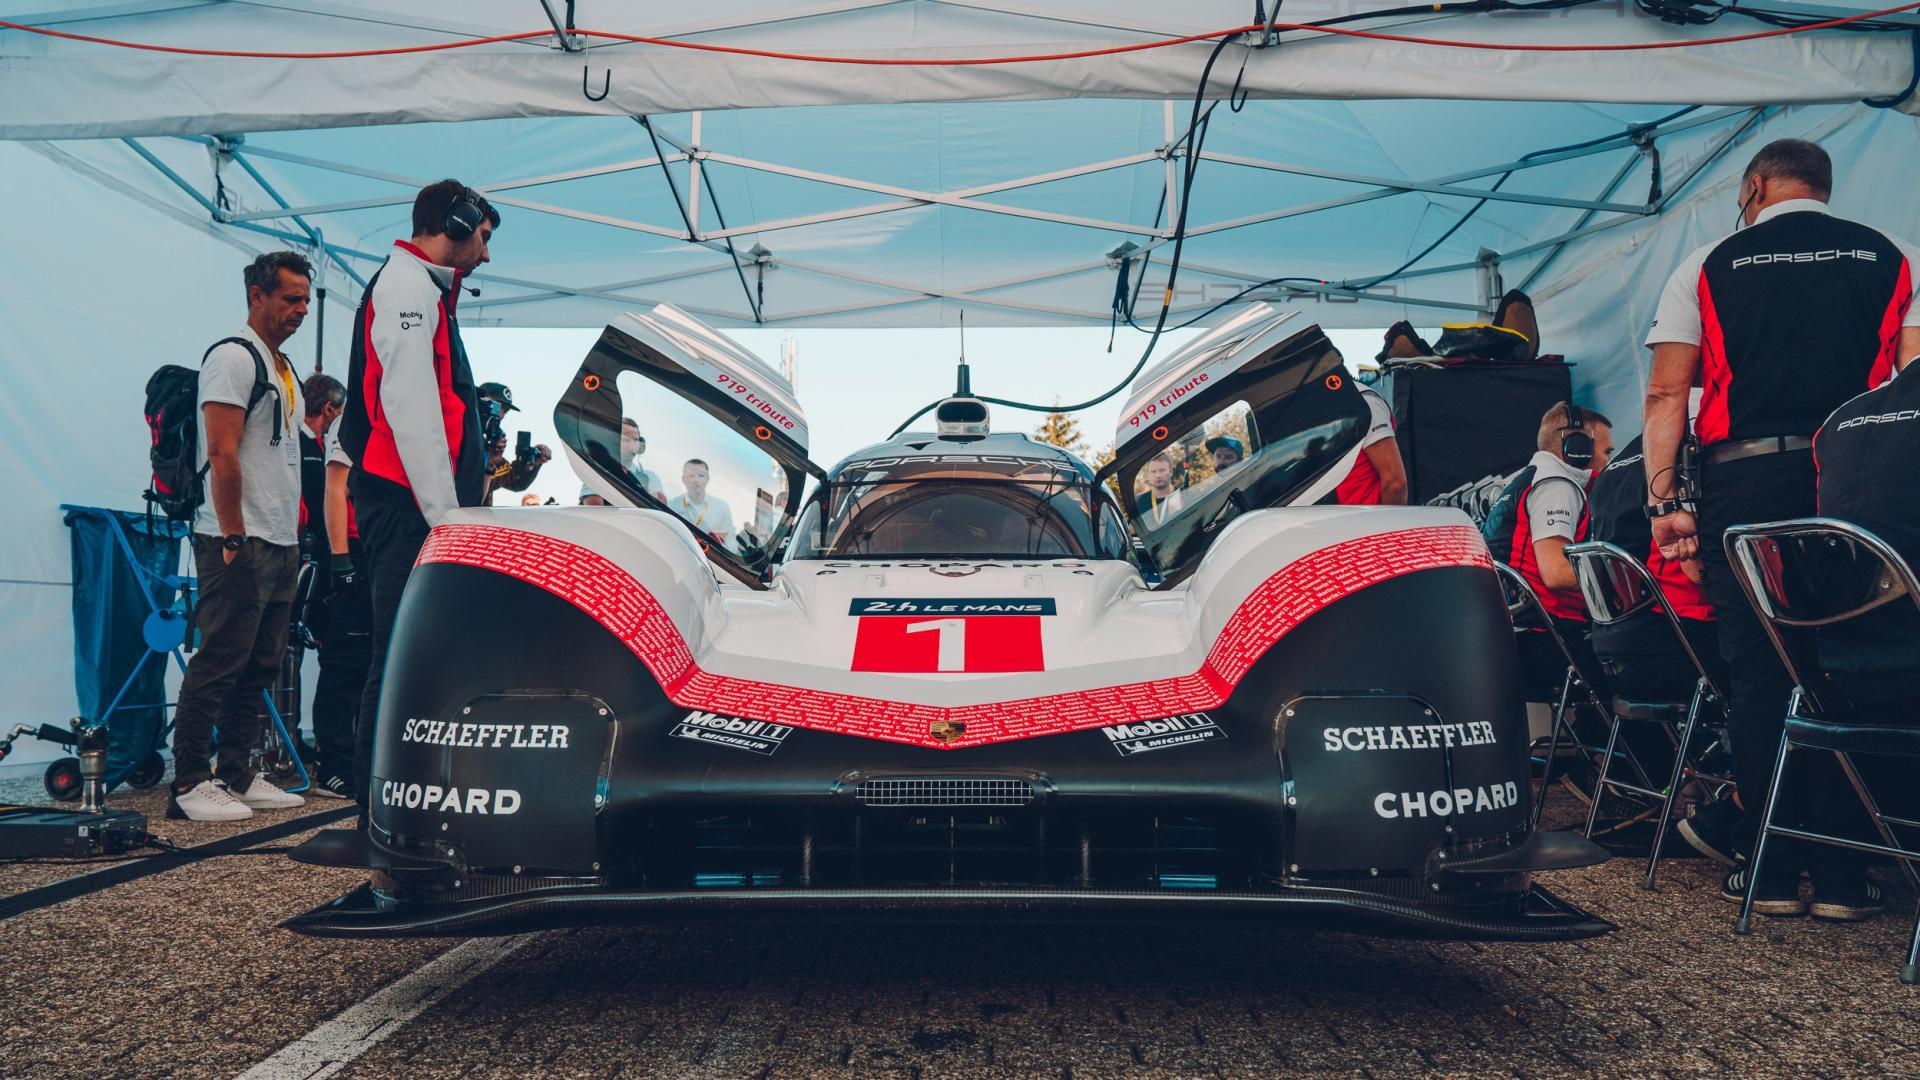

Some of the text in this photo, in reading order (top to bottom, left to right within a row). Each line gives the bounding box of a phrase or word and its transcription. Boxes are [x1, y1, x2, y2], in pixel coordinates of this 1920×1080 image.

[1732, 249, 1877, 270] PORSCHE
[717, 374, 794, 430] 919 tribute
[1129, 373, 1208, 428] 919 tribute
[840, 456, 1079, 474] PORSCHE
[906, 618, 966, 672] 1
[402, 718, 570, 749] SCHAEFFLER
[682, 710, 766, 735] Mobil
[1101, 716, 1187, 741] Mobil
[1323, 720, 1497, 752] SCHAEFFLER
[701, 732, 769, 749] MICHELIN
[1148, 731, 1214, 747] MICHELIN
[382, 780, 522, 815] CHOPARD
[1373, 781, 1518, 819] CHOPARD
